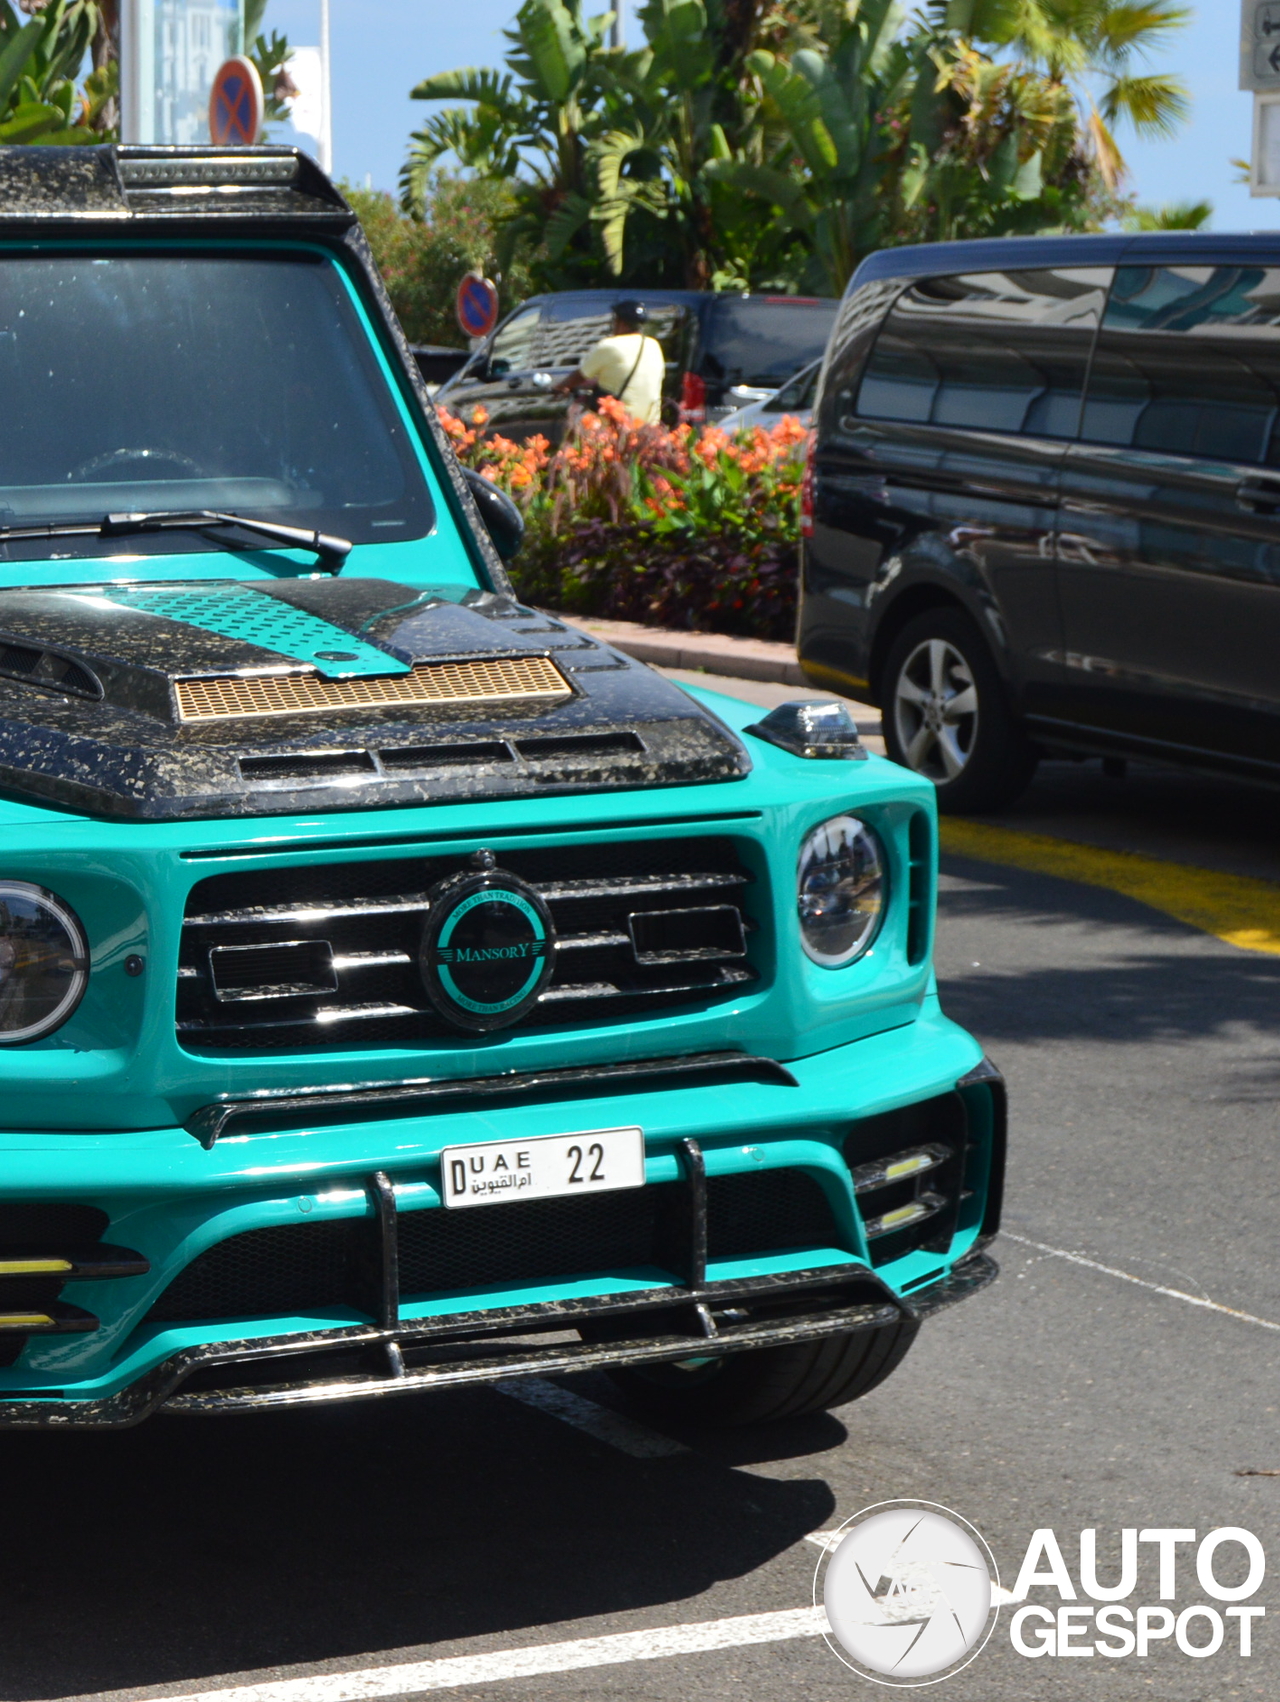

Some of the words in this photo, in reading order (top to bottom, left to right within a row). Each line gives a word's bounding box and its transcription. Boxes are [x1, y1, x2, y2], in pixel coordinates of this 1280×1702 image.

[452, 899, 471, 920] MORE
[473, 892, 495, 904] THAN
[495, 891, 531, 914] TRADITION
[456, 943, 530, 962] MANSORY
[478, 1003, 499, 1013] THAN
[451, 1159, 467, 1196] D
[567, 1143, 606, 1184] 22
